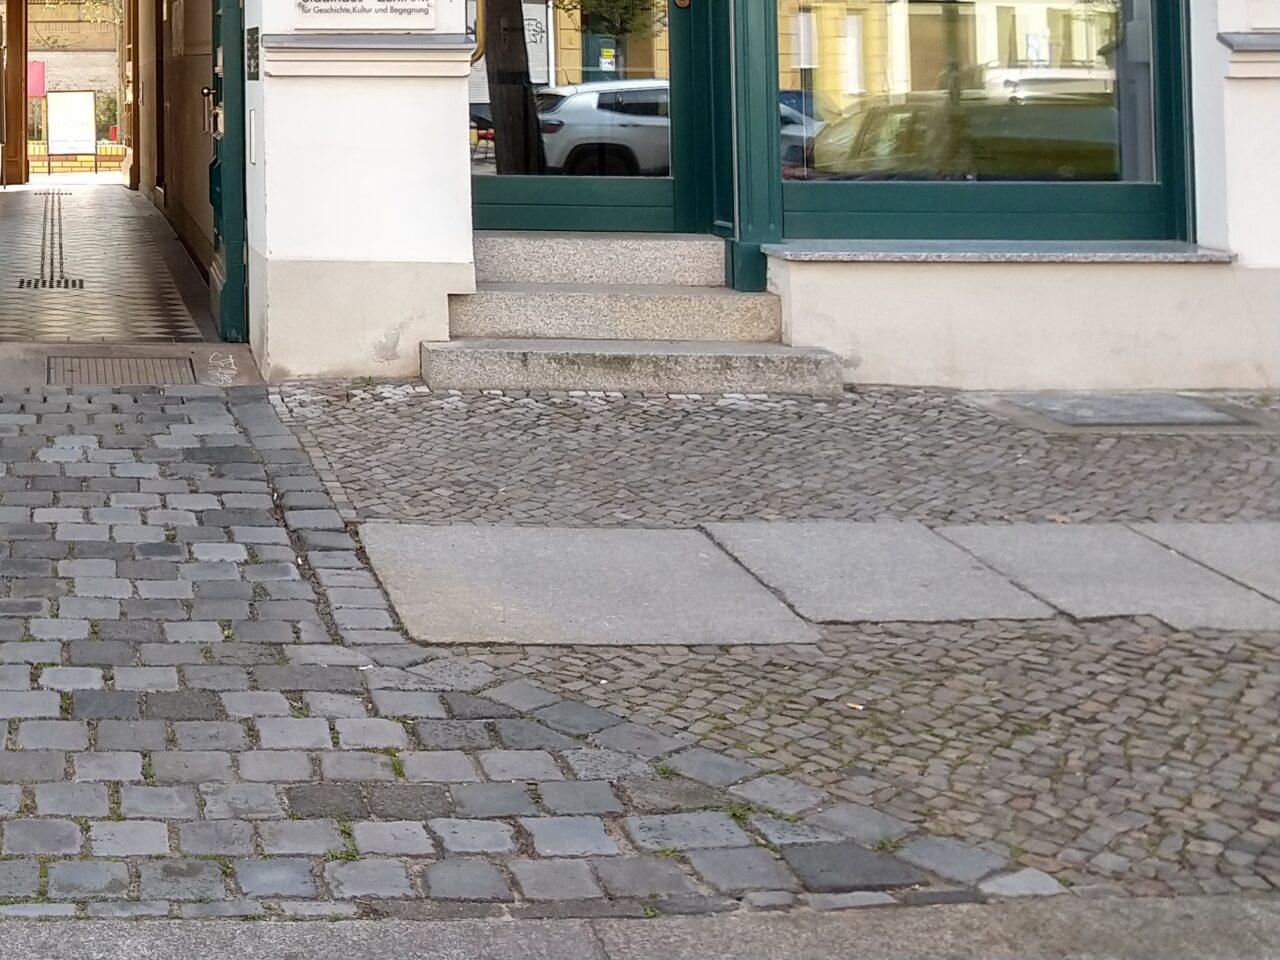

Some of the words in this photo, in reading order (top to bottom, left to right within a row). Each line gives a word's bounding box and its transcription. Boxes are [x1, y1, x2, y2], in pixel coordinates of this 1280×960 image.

[301, 5, 312, 14] für
[375, 5, 388, 14] und
[389, 5, 429, 16] Begegnung
